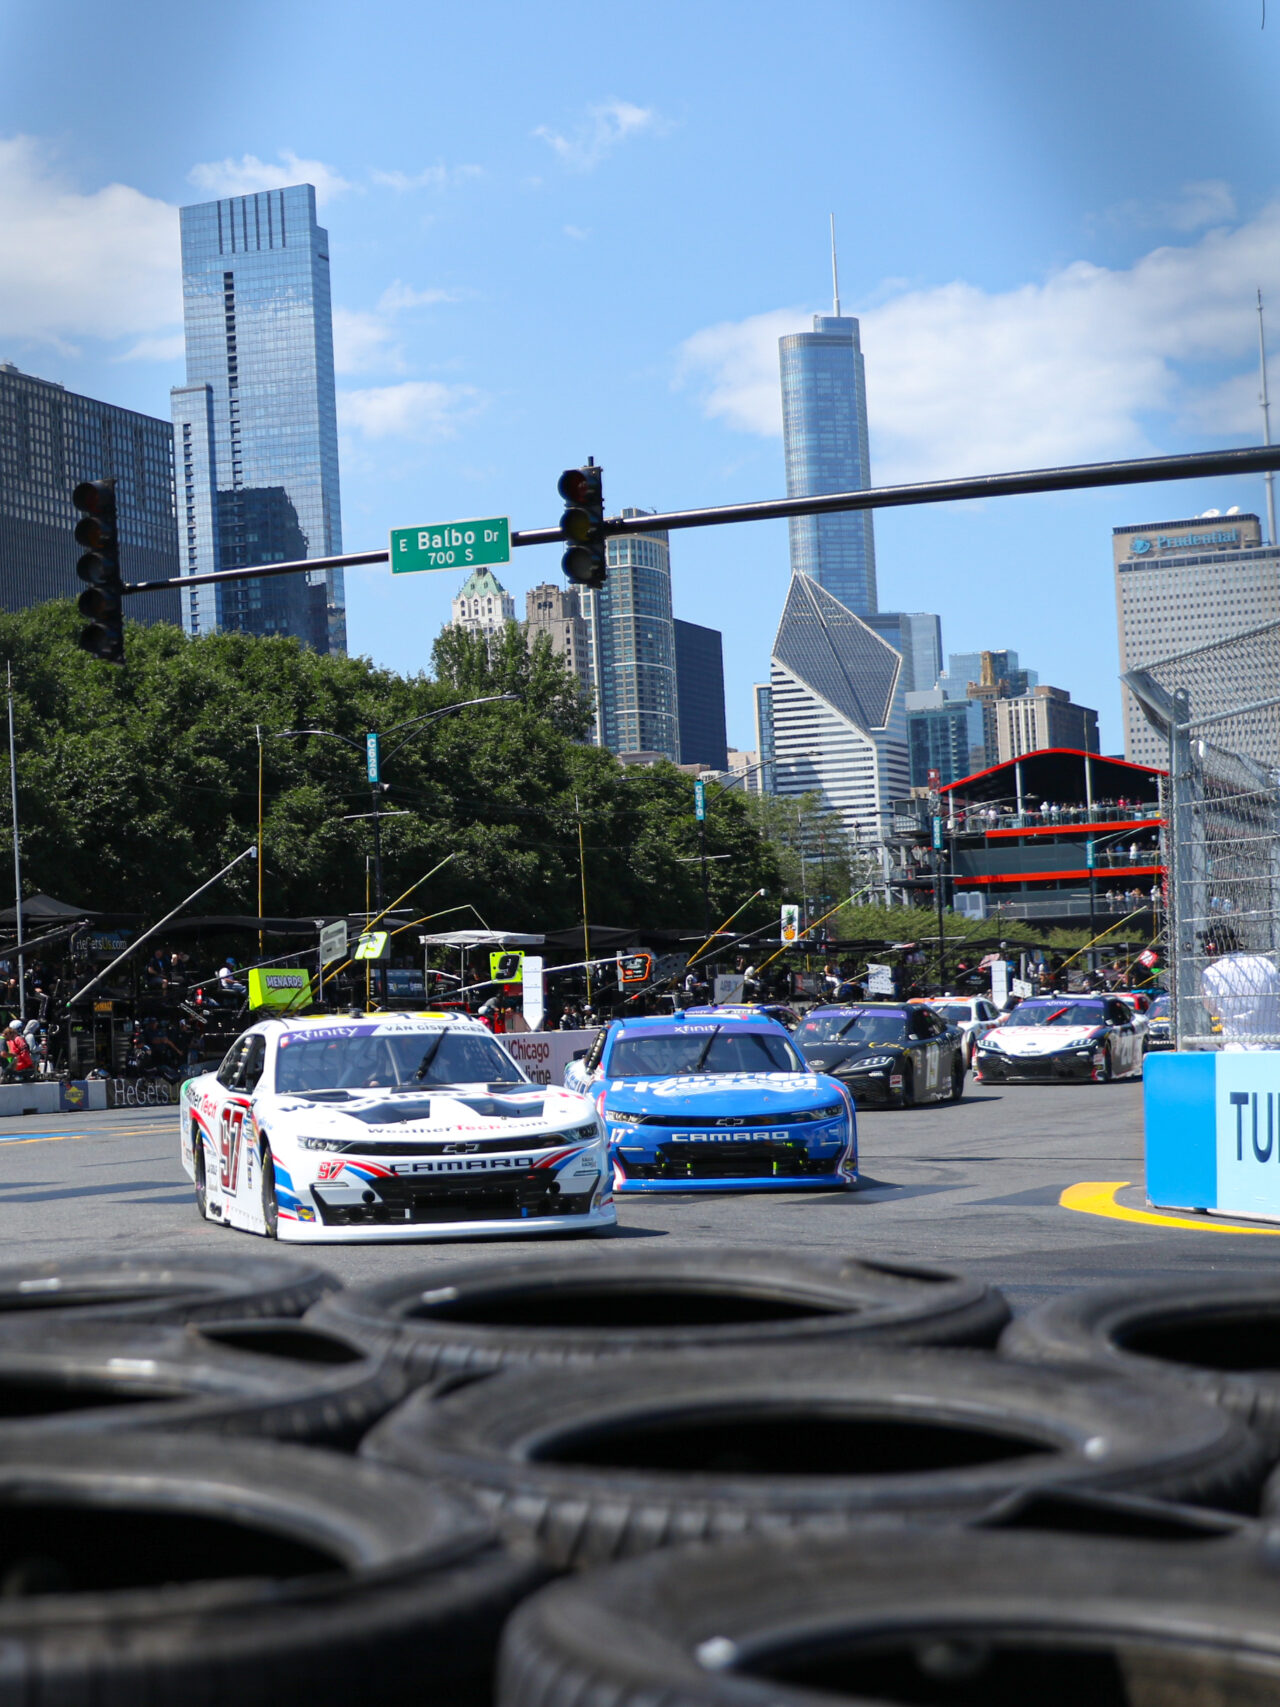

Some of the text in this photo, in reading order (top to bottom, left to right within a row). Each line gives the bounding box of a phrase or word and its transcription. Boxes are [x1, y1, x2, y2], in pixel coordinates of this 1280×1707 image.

[399, 529, 499, 552] E Balbo Dr
[1156, 528, 1238, 549] Prudential
[428, 549, 474, 565] 700 S
[355, 931, 388, 960] 19
[265, 975, 303, 988] MENARDS
[292, 1026, 359, 1041] xfinity
[674, 1024, 725, 1034] xfinity
[367, 1120, 548, 1134] WeatherTech.com
[1230, 1092, 1280, 1163] TU
[609, 1128, 626, 1143] 17
[671, 1130, 790, 1142] CAMARO
[221, 1104, 246, 1195] 97
[317, 1160, 345, 1181] 97
[390, 1157, 534, 1174] CAMARO
